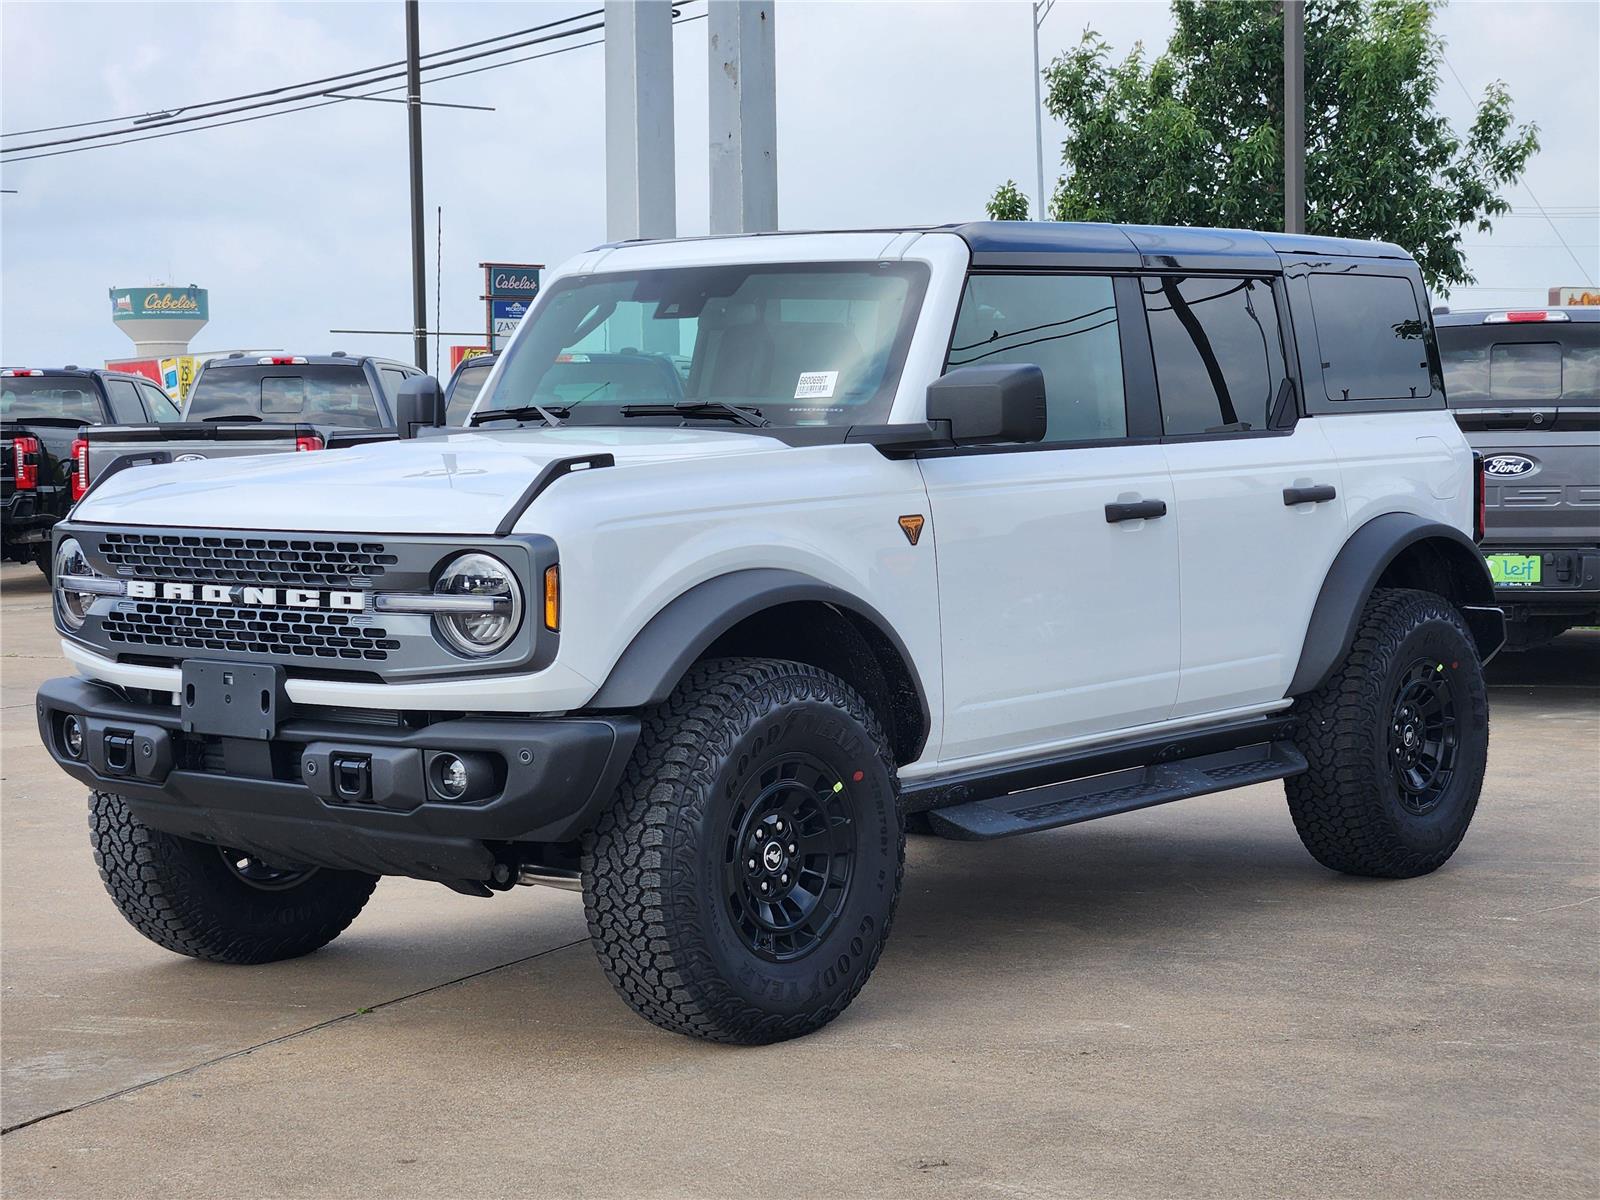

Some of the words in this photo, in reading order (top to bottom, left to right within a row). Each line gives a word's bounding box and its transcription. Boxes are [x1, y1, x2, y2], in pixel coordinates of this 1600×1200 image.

[496, 273, 537, 290] Cabela's
[496, 321, 520, 333] ZAX
[1488, 458, 1524, 473] Ford
[127, 580, 366, 610] BRONCO
[725, 706, 866, 799] GOODYEAR
